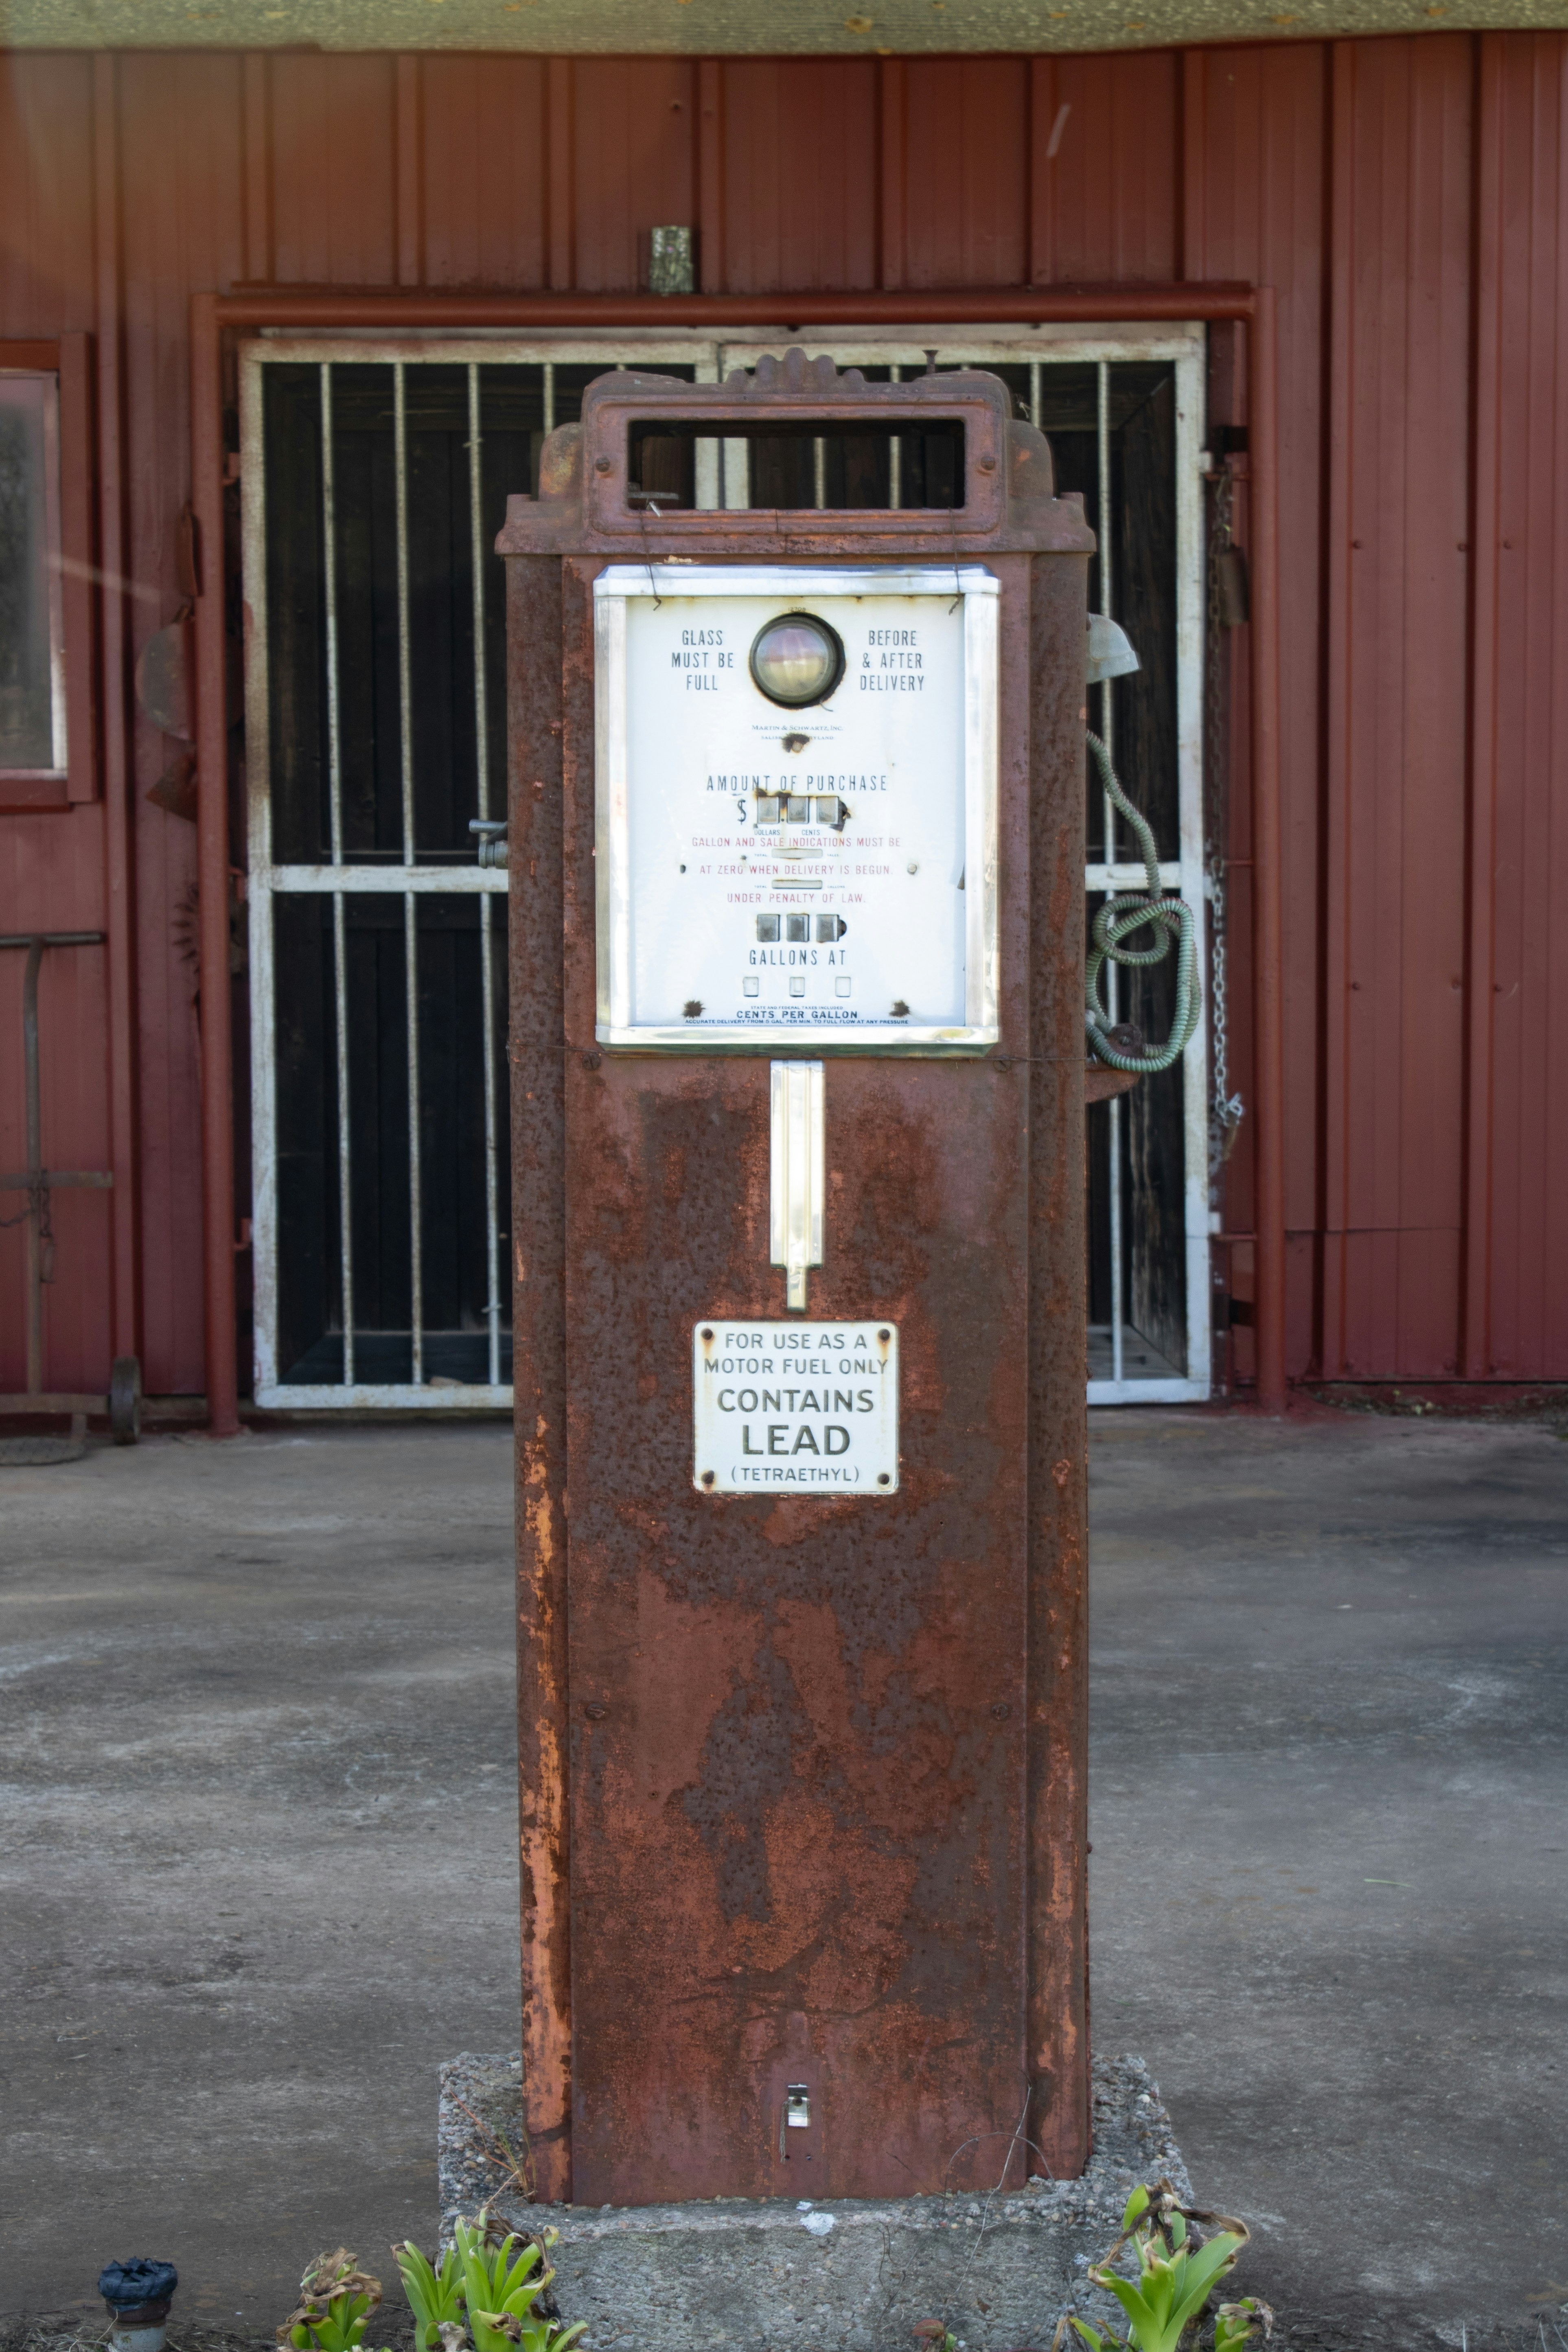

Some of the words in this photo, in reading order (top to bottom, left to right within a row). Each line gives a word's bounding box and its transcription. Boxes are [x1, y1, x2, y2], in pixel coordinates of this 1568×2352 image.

[681, 629, 723, 646] GLASS
[868, 629, 917, 646] BEFORE
[671, 652, 709, 668] MUST
[718, 652, 734, 668] BE
[862, 652, 871, 668] &
[880, 652, 922, 669] AFTER
[686, 674, 718, 691] FULL
[860, 675, 925, 692] DELIVERY
[707, 775, 770, 791] AMOUNT
[780, 775, 797, 791] OF
[807, 775, 887, 791] PURCHASE
[736, 798, 747, 825] $
[692, 837, 730, 847] GALLON
[736, 837, 755, 847] AND
[760, 837, 784, 847] SALE
[789, 837, 851, 847] INDICATIONS
[857, 837, 882, 847] MUST
[889, 837, 900, 847] BE
[700, 865, 712, 874] AT
[718, 865, 743, 874] ZERO
[749, 865, 778, 874] WHEN
[785, 865, 834, 874] DELIVERY
[840, 865, 850, 874] IS
[856, 865, 893, 875] BEGUN.
[727, 893, 761, 903] UNDER
[769, 893, 814, 903] PENALTY
[822, 893, 834, 903] OF
[842, 893, 865, 903] LAW.
[749, 949, 817, 966] GALLONS
[828, 949, 846, 966] AT
[736, 1011, 775, 1019] CENTS
[782, 1011, 804, 1019] PER
[811, 1011, 857, 1019] GALLON
[725, 1333, 764, 1349] FOR
[773, 1333, 811, 1350] USE
[818, 1333, 845, 1350] AS
[853, 1334, 867, 1349] A
[704, 1358, 774, 1374] MOTOR
[782, 1358, 832, 1375] FUEL
[838, 1358, 889, 1375] ONLY
[717, 1388, 874, 1413] CONTAINS
[742, 1424, 851, 1456] LEAD
[731, 1465, 860, 1483] (TETRAETHYL)
